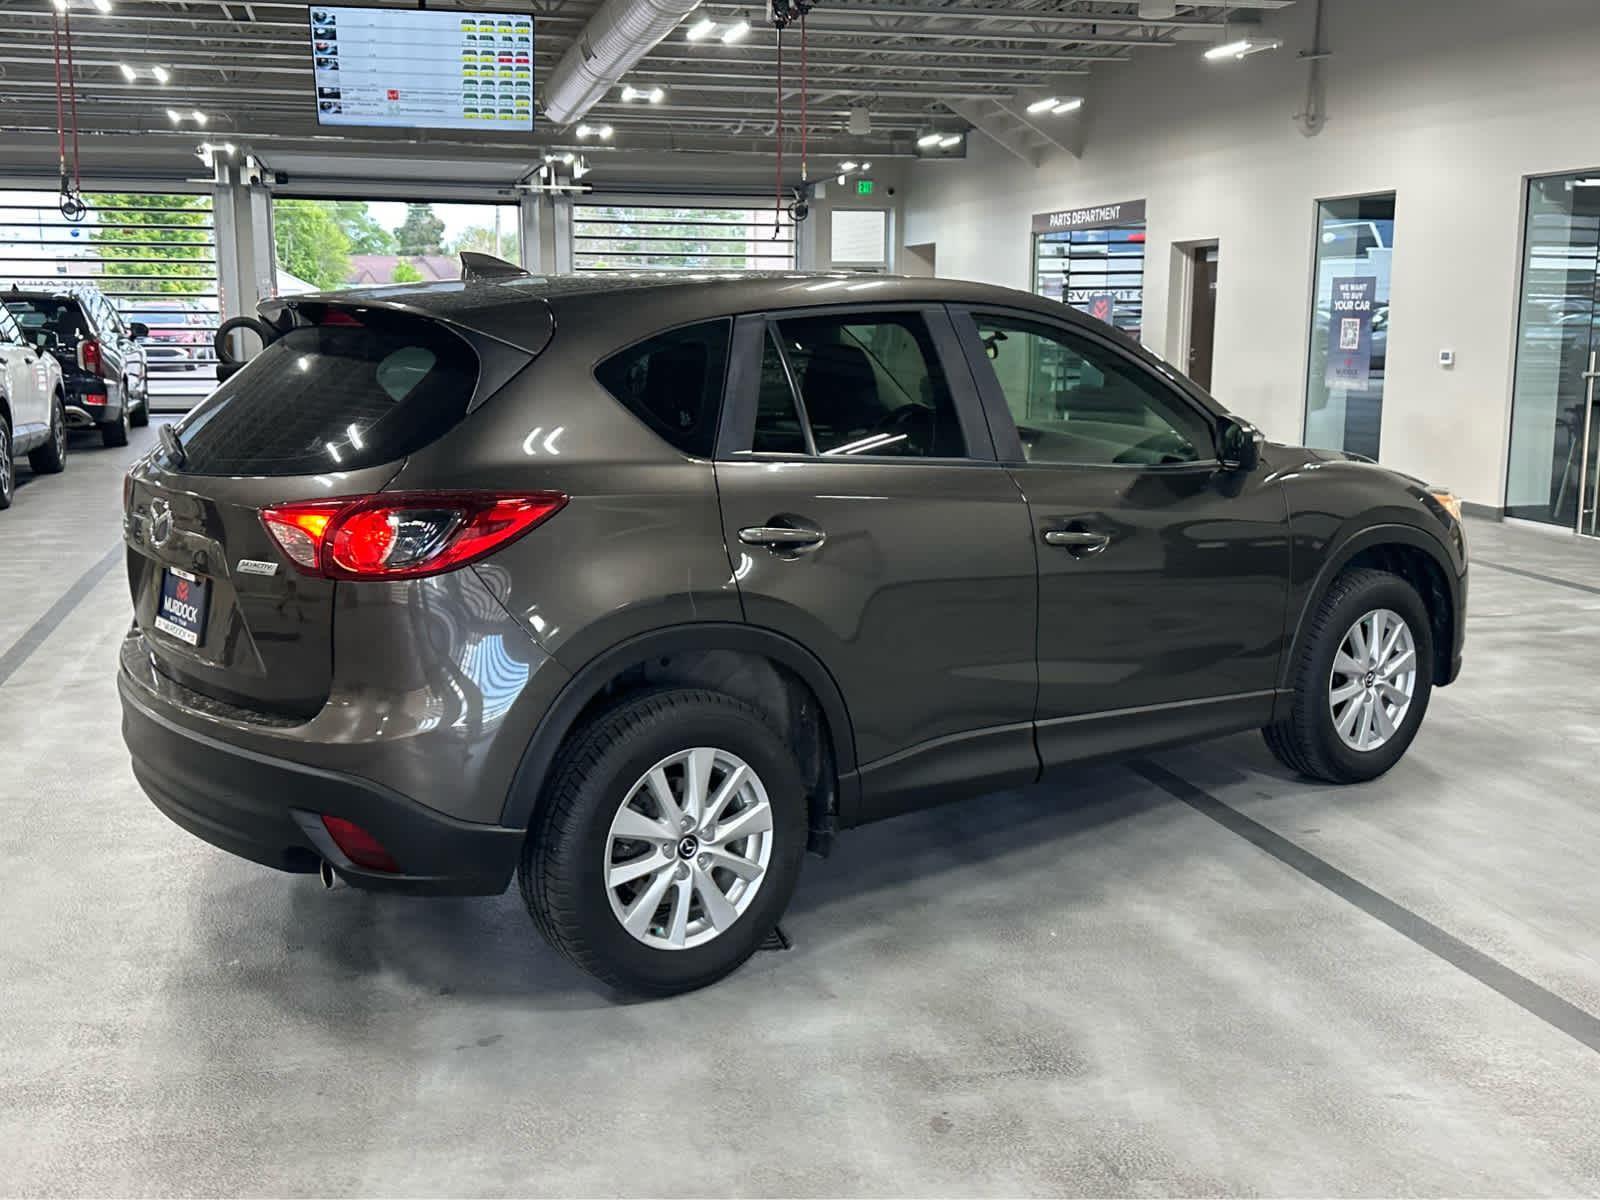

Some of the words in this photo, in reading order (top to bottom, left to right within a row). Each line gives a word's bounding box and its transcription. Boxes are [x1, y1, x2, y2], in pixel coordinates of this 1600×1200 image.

[1049, 212, 1072, 227] PARTS
[1072, 206, 1121, 225] DEPARTMENT
[1334, 300, 1354, 311] YOUR
[1354, 300, 1371, 311] CAR
[164, 595, 198, 623] MURDOCK
